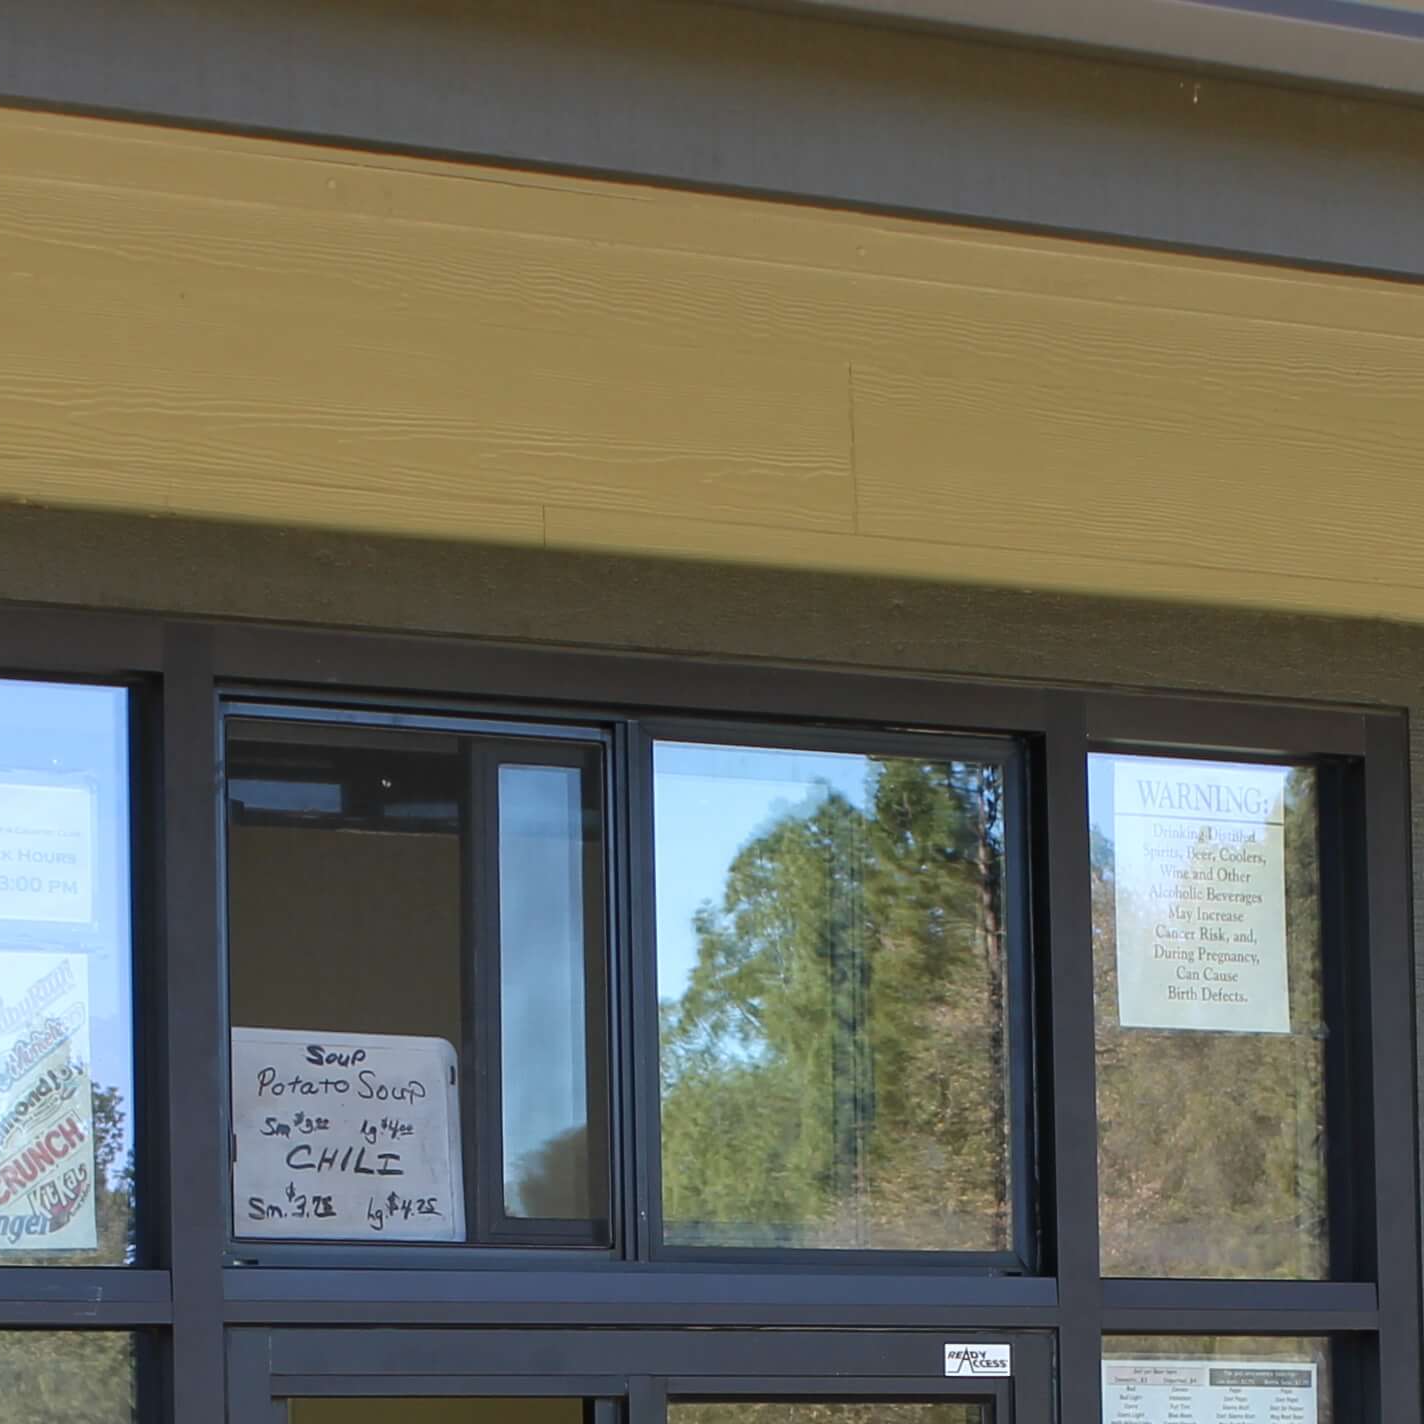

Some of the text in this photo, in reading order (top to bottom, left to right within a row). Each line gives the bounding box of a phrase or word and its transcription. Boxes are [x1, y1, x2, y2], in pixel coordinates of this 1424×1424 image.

[1136, 779, 1269, 815] WARNING:
[1219, 847, 1267, 866] Coolers,
[1217, 867, 1251, 883] Other
[1206, 887, 1264, 906] Beverages
[1168, 904, 1245, 923] May Increase
[1200, 926, 1230, 943] Risk,
[1153, 944, 1261, 966] During Pregnancy,
[1176, 965, 1238, 983] Can Cause
[1167, 985, 1249, 1003] Birth Defects.
[257, 1066, 426, 1104] Potato Soup
[285, 1144, 405, 1176] CHILI
